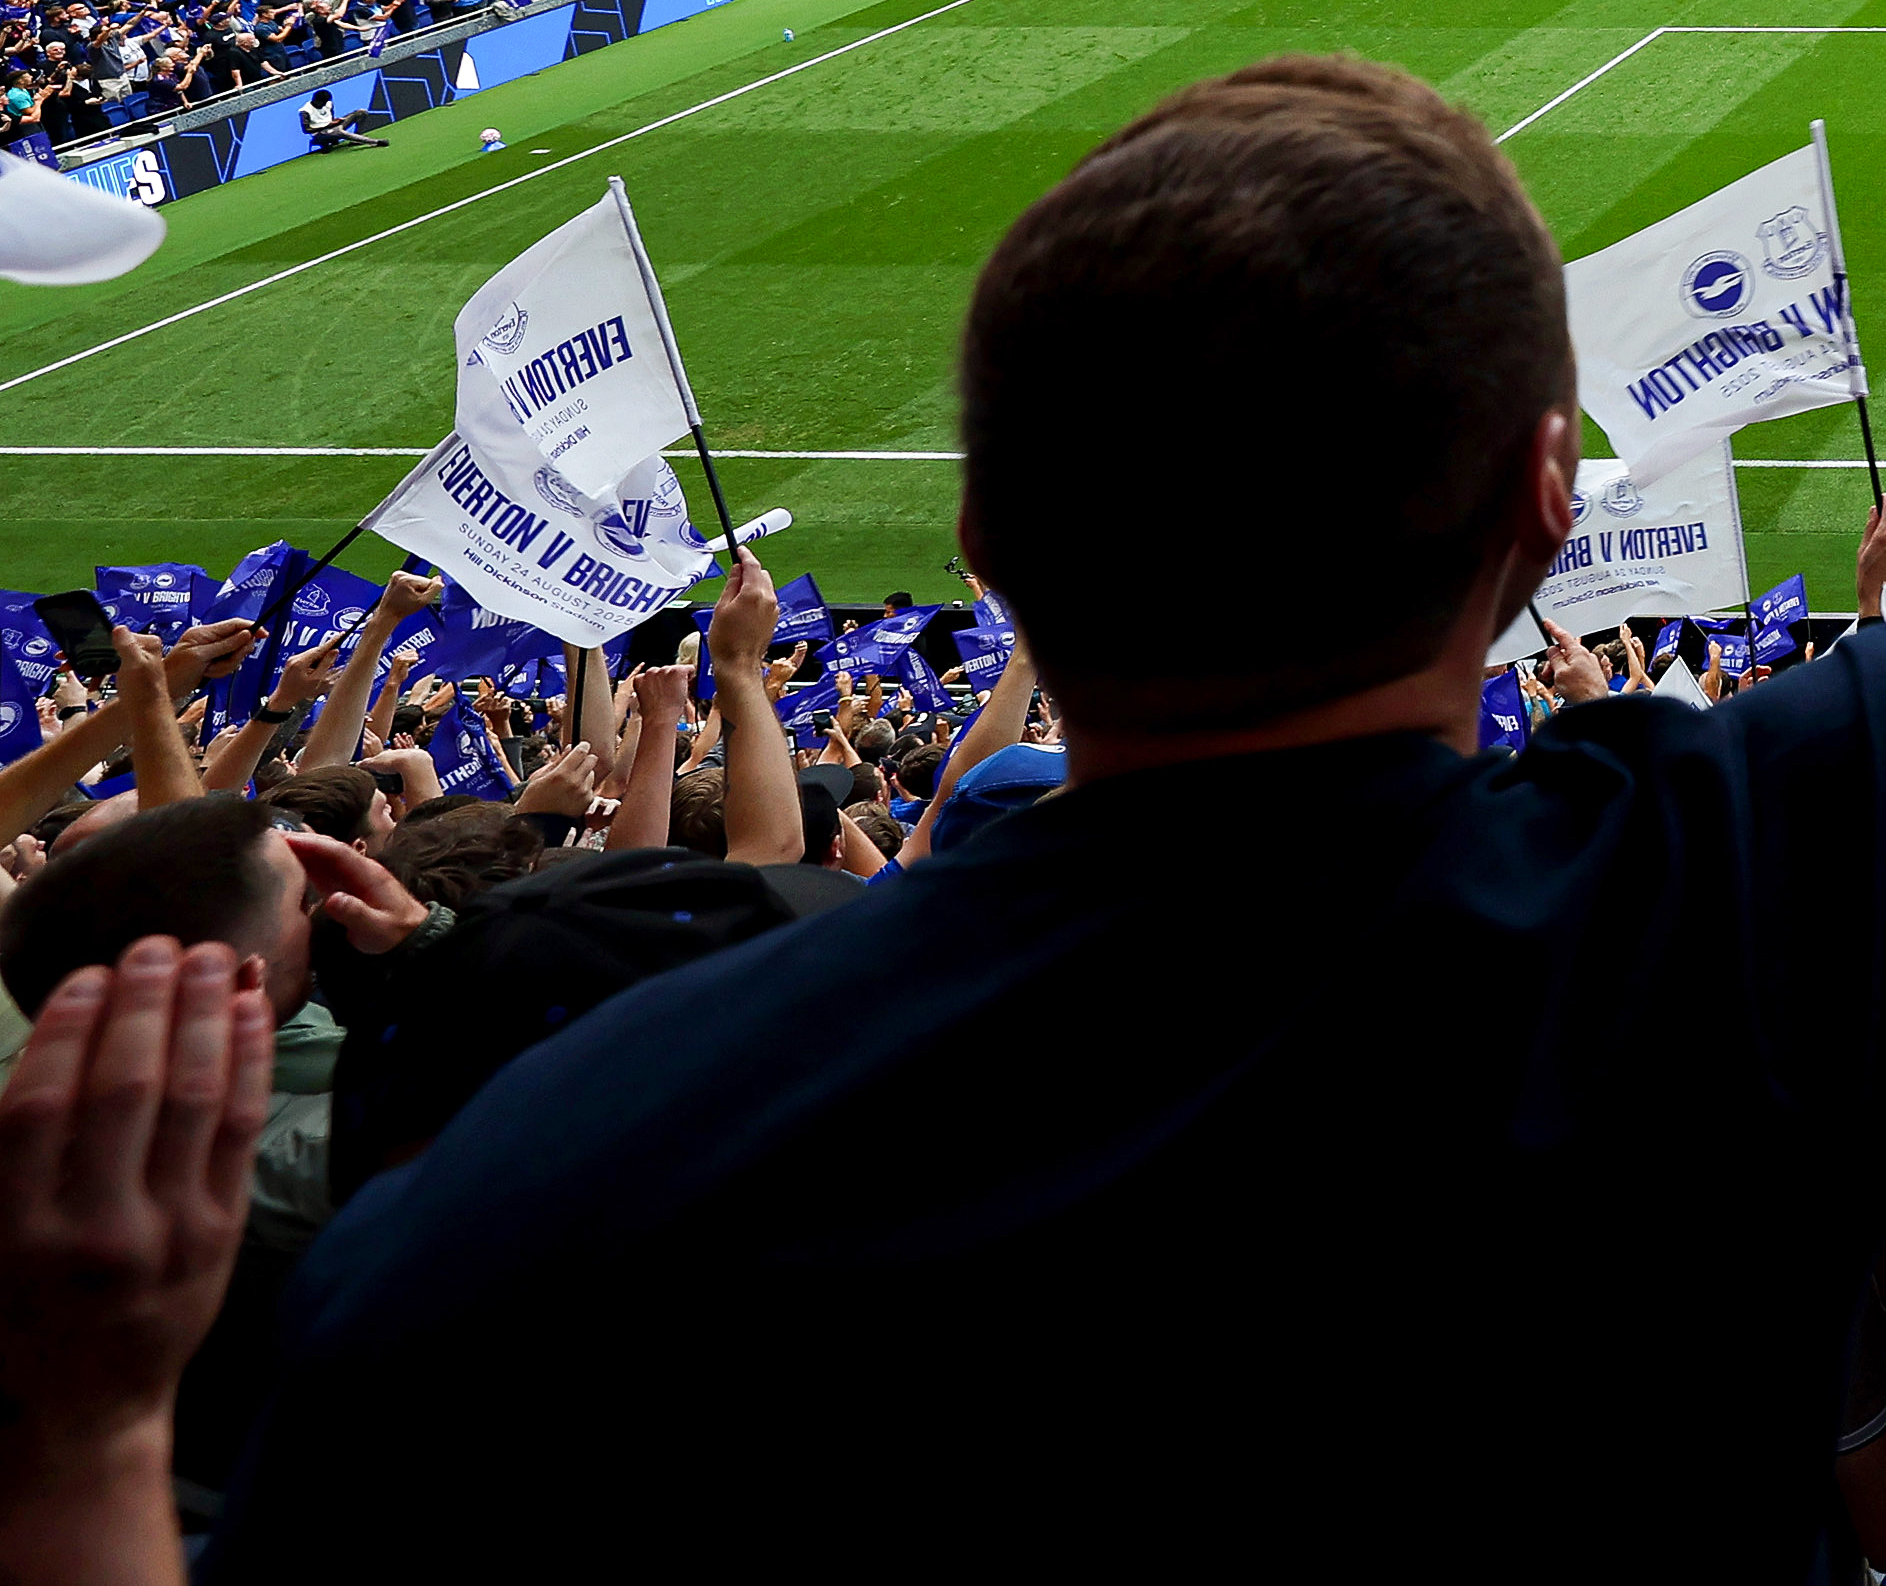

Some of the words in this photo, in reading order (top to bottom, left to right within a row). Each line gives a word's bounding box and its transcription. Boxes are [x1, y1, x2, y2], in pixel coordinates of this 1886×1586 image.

[437, 442, 549, 554] EVERTON
[537, 530, 575, 570] V
[458, 522, 511, 565] SUNDAY
[510, 563, 530, 578] 24
[532, 576, 590, 612] AUGUST
[596, 607, 636, 627] 2025
[463, 547, 485, 566] Hill
[483, 562, 549, 605] Dickinson
[550, 601, 606, 632] Stadium
